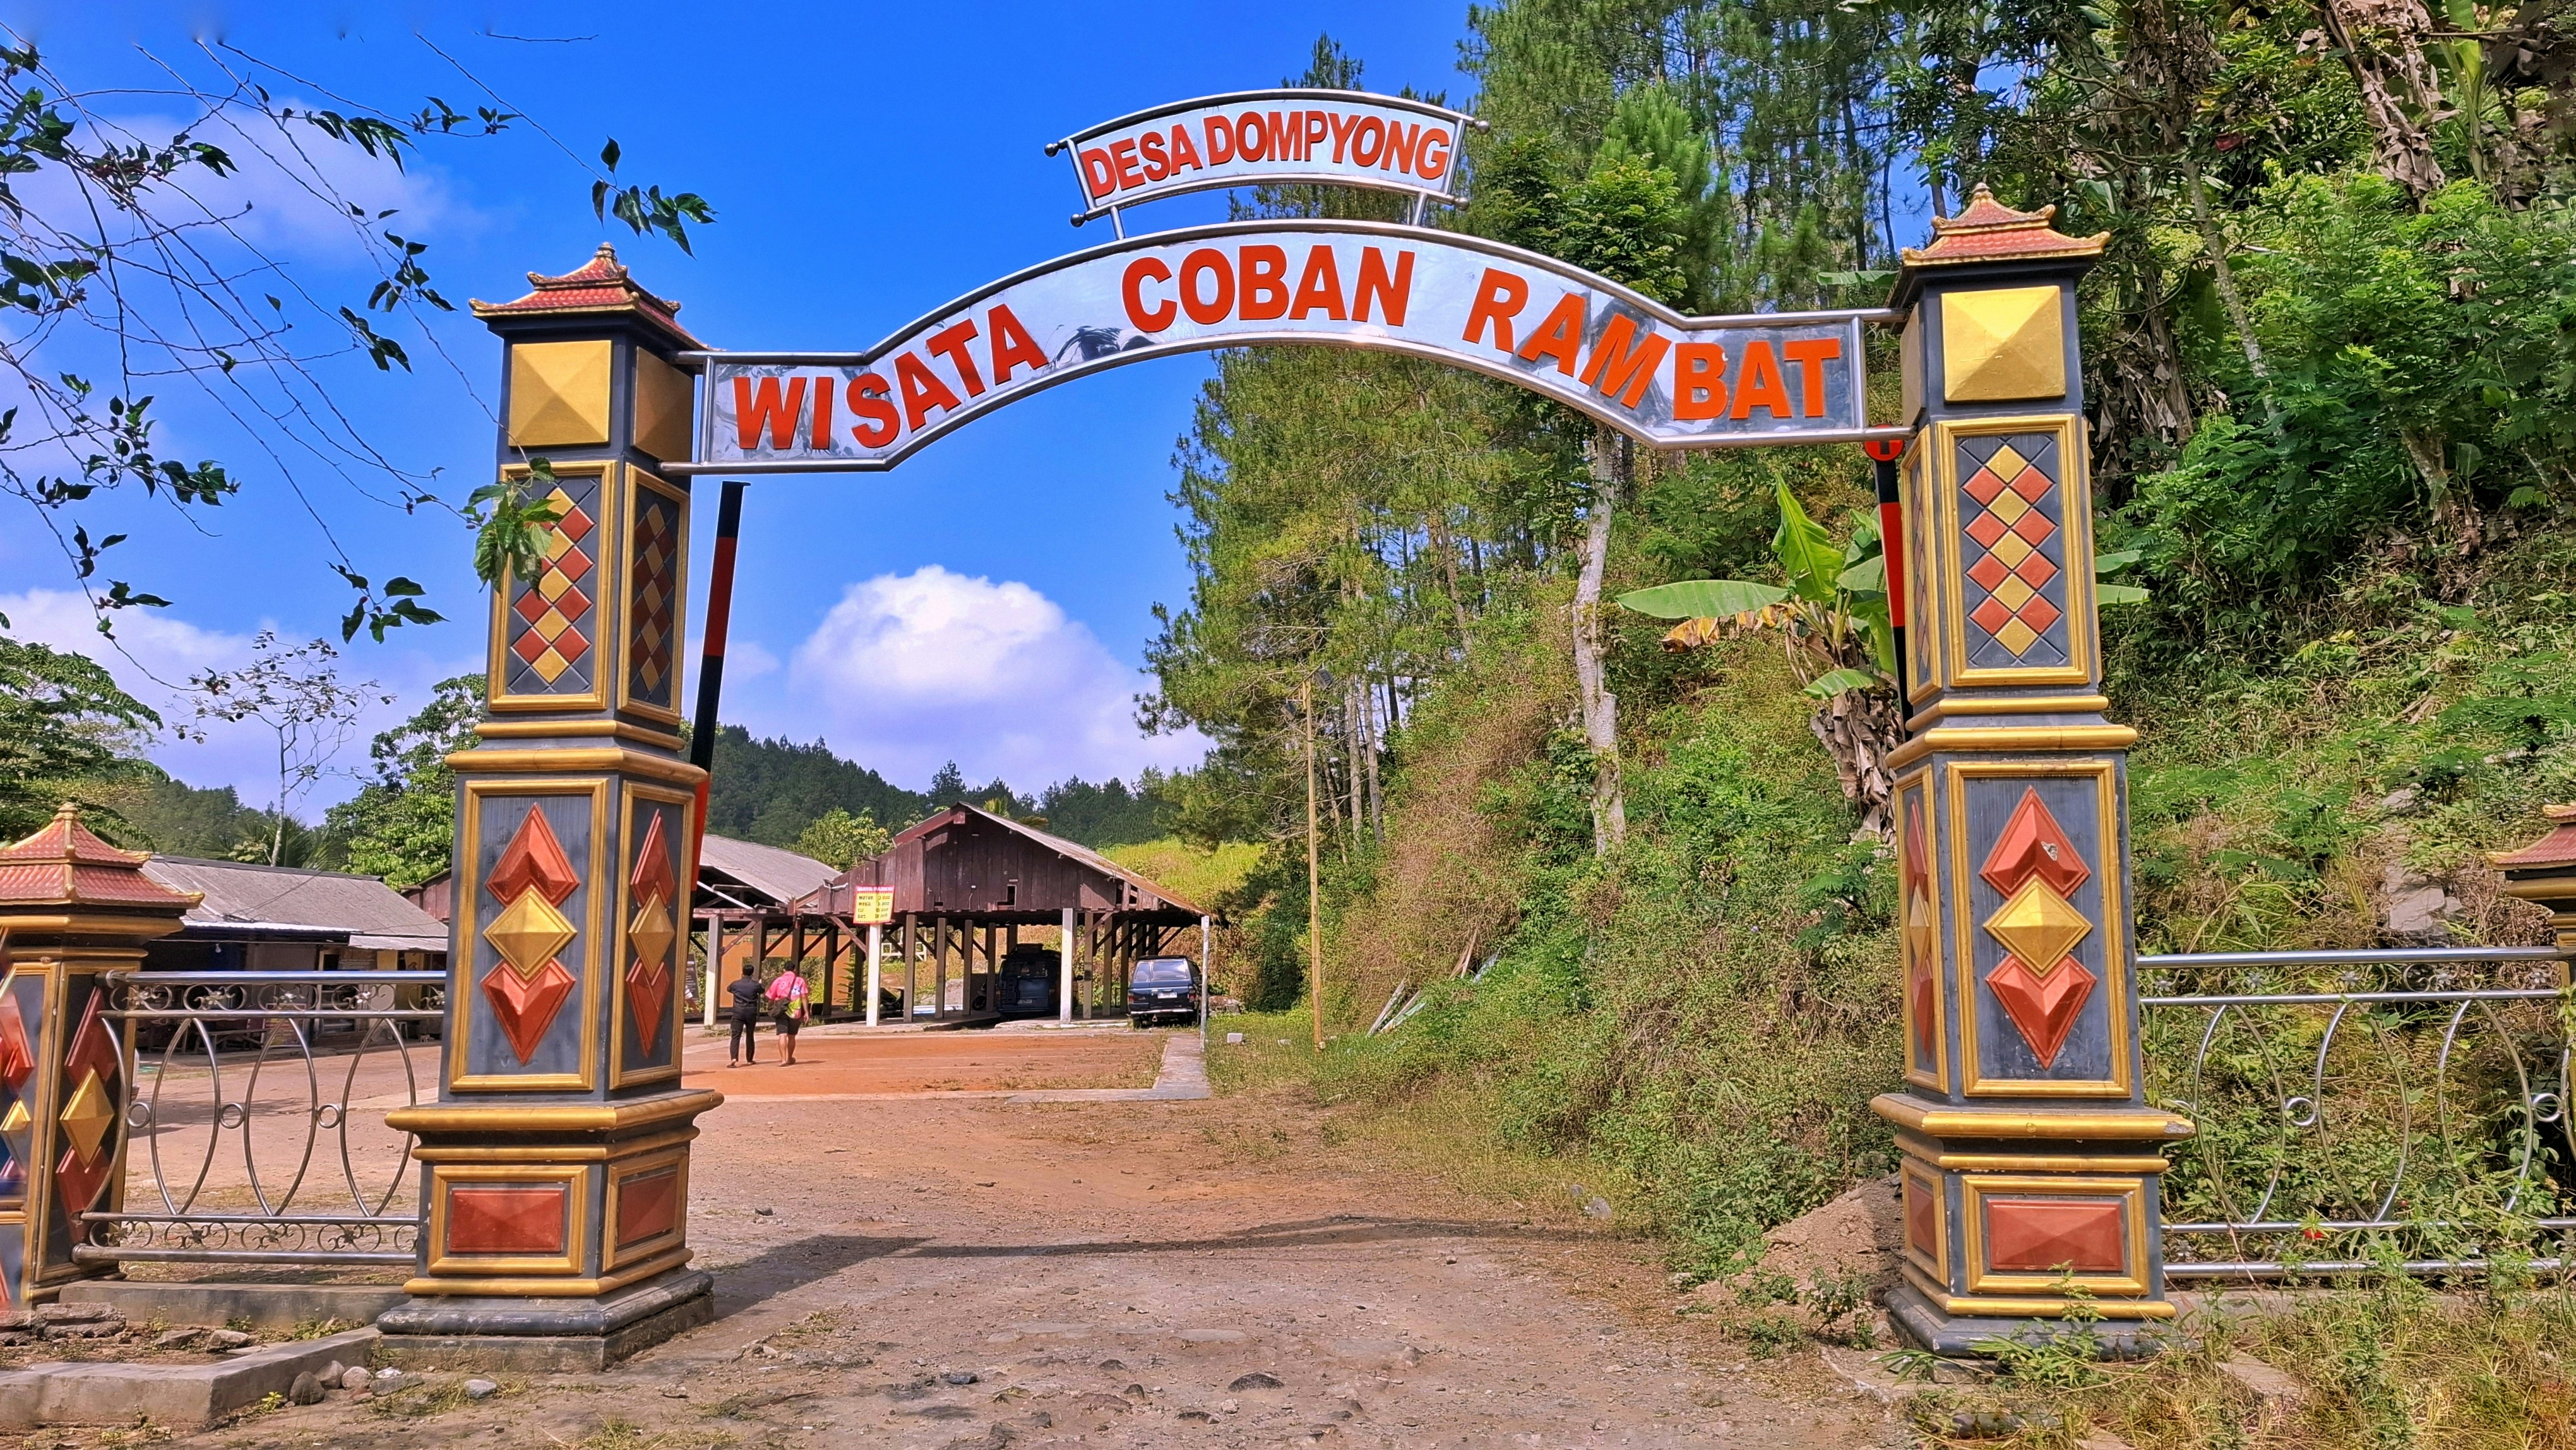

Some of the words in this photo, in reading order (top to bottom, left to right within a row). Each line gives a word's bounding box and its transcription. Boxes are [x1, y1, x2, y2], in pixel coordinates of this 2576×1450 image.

[1080, 123, 1203, 198] DESA
[1203, 111, 1450, 180] DOMPYONG
[733, 304, 1049, 449] WISATA
[1122, 244, 1416, 333] COBAN
[1462, 268, 1841, 421] RAMBAT
